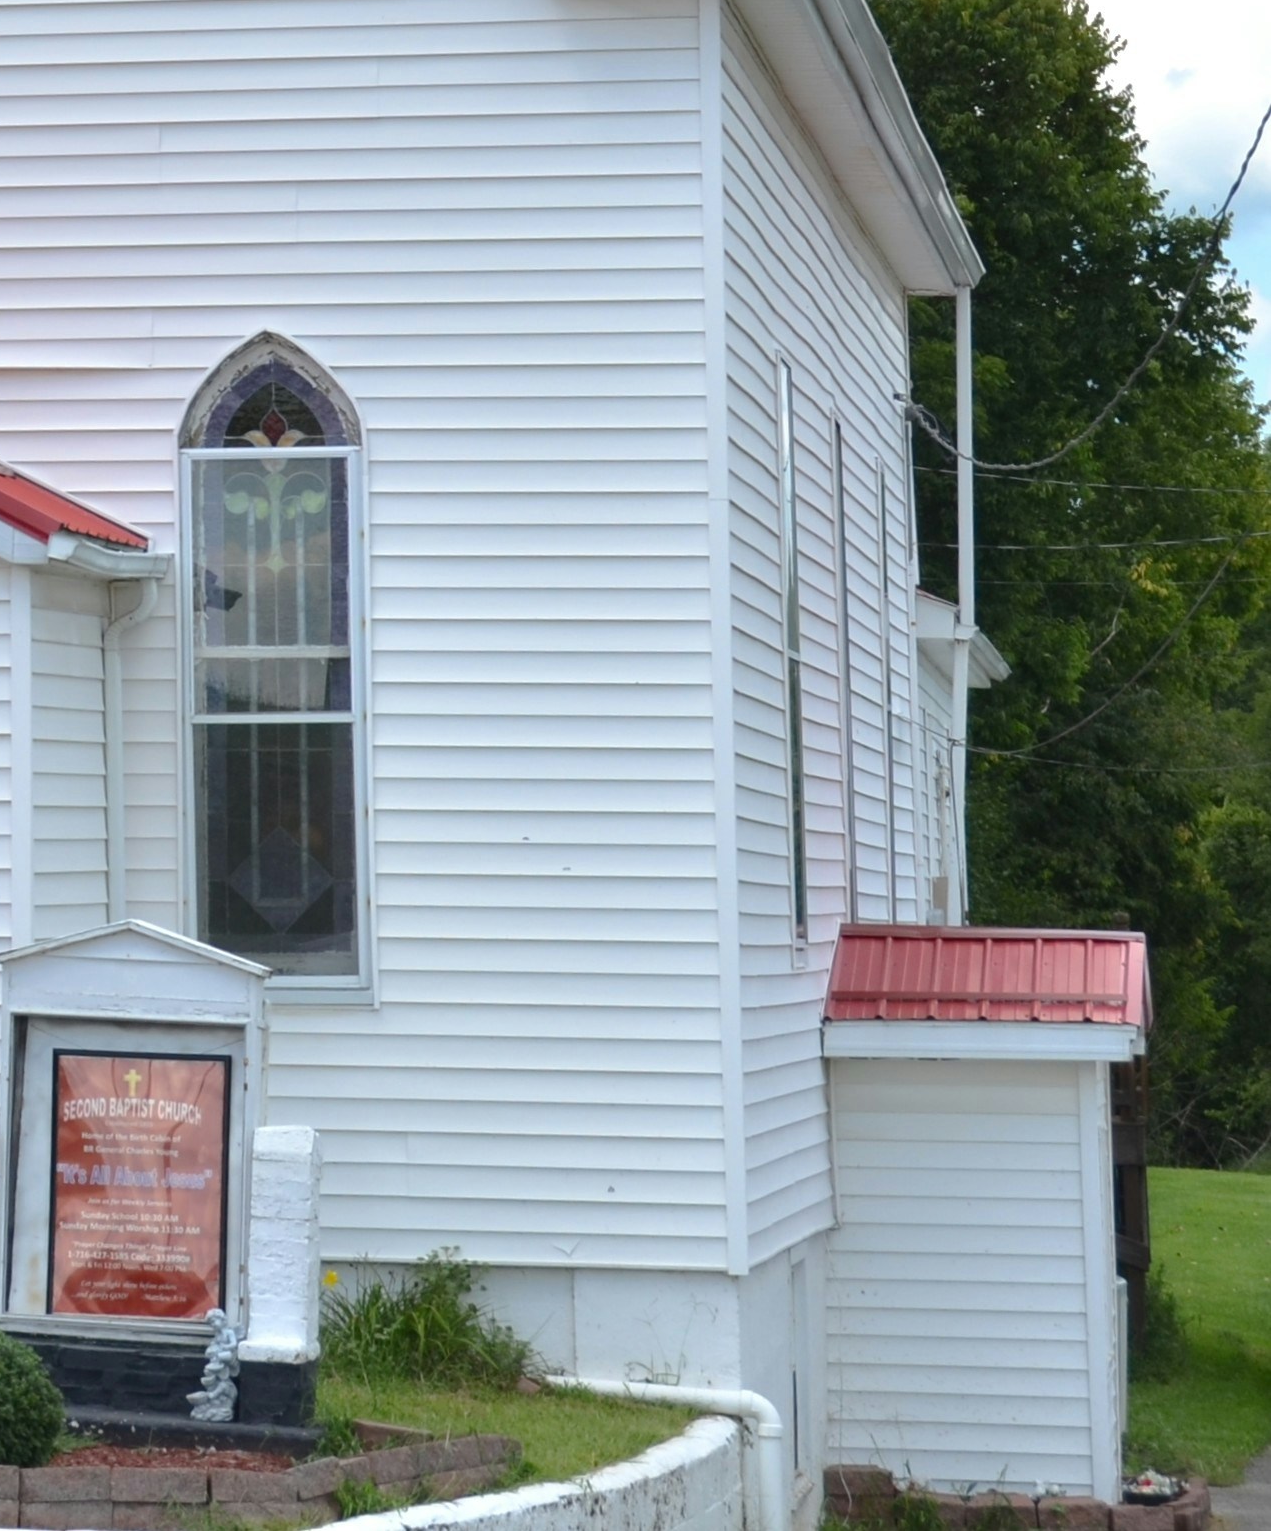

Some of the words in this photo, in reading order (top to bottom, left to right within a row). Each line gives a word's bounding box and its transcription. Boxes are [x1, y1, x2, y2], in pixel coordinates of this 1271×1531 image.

[64, 1098, 106, 1122] SECOND
[109, 1097, 155, 1119] BAPTIST
[157, 1100, 202, 1125] CHURCH
[81, 1132, 105, 1141] Home
[95, 1146, 125, 1155] General
[90, 1164, 111, 1186] All
[114, 1165, 158, 1188] About
[81, 1211, 110, 1221] Sunday
[111, 1211, 139, 1221] School
[164, 1214, 179, 1223] AM
[59, 1221, 88, 1231] Sunday
[89, 1222, 124, 1233] Morning
[125, 1224, 159, 1234] Worship
